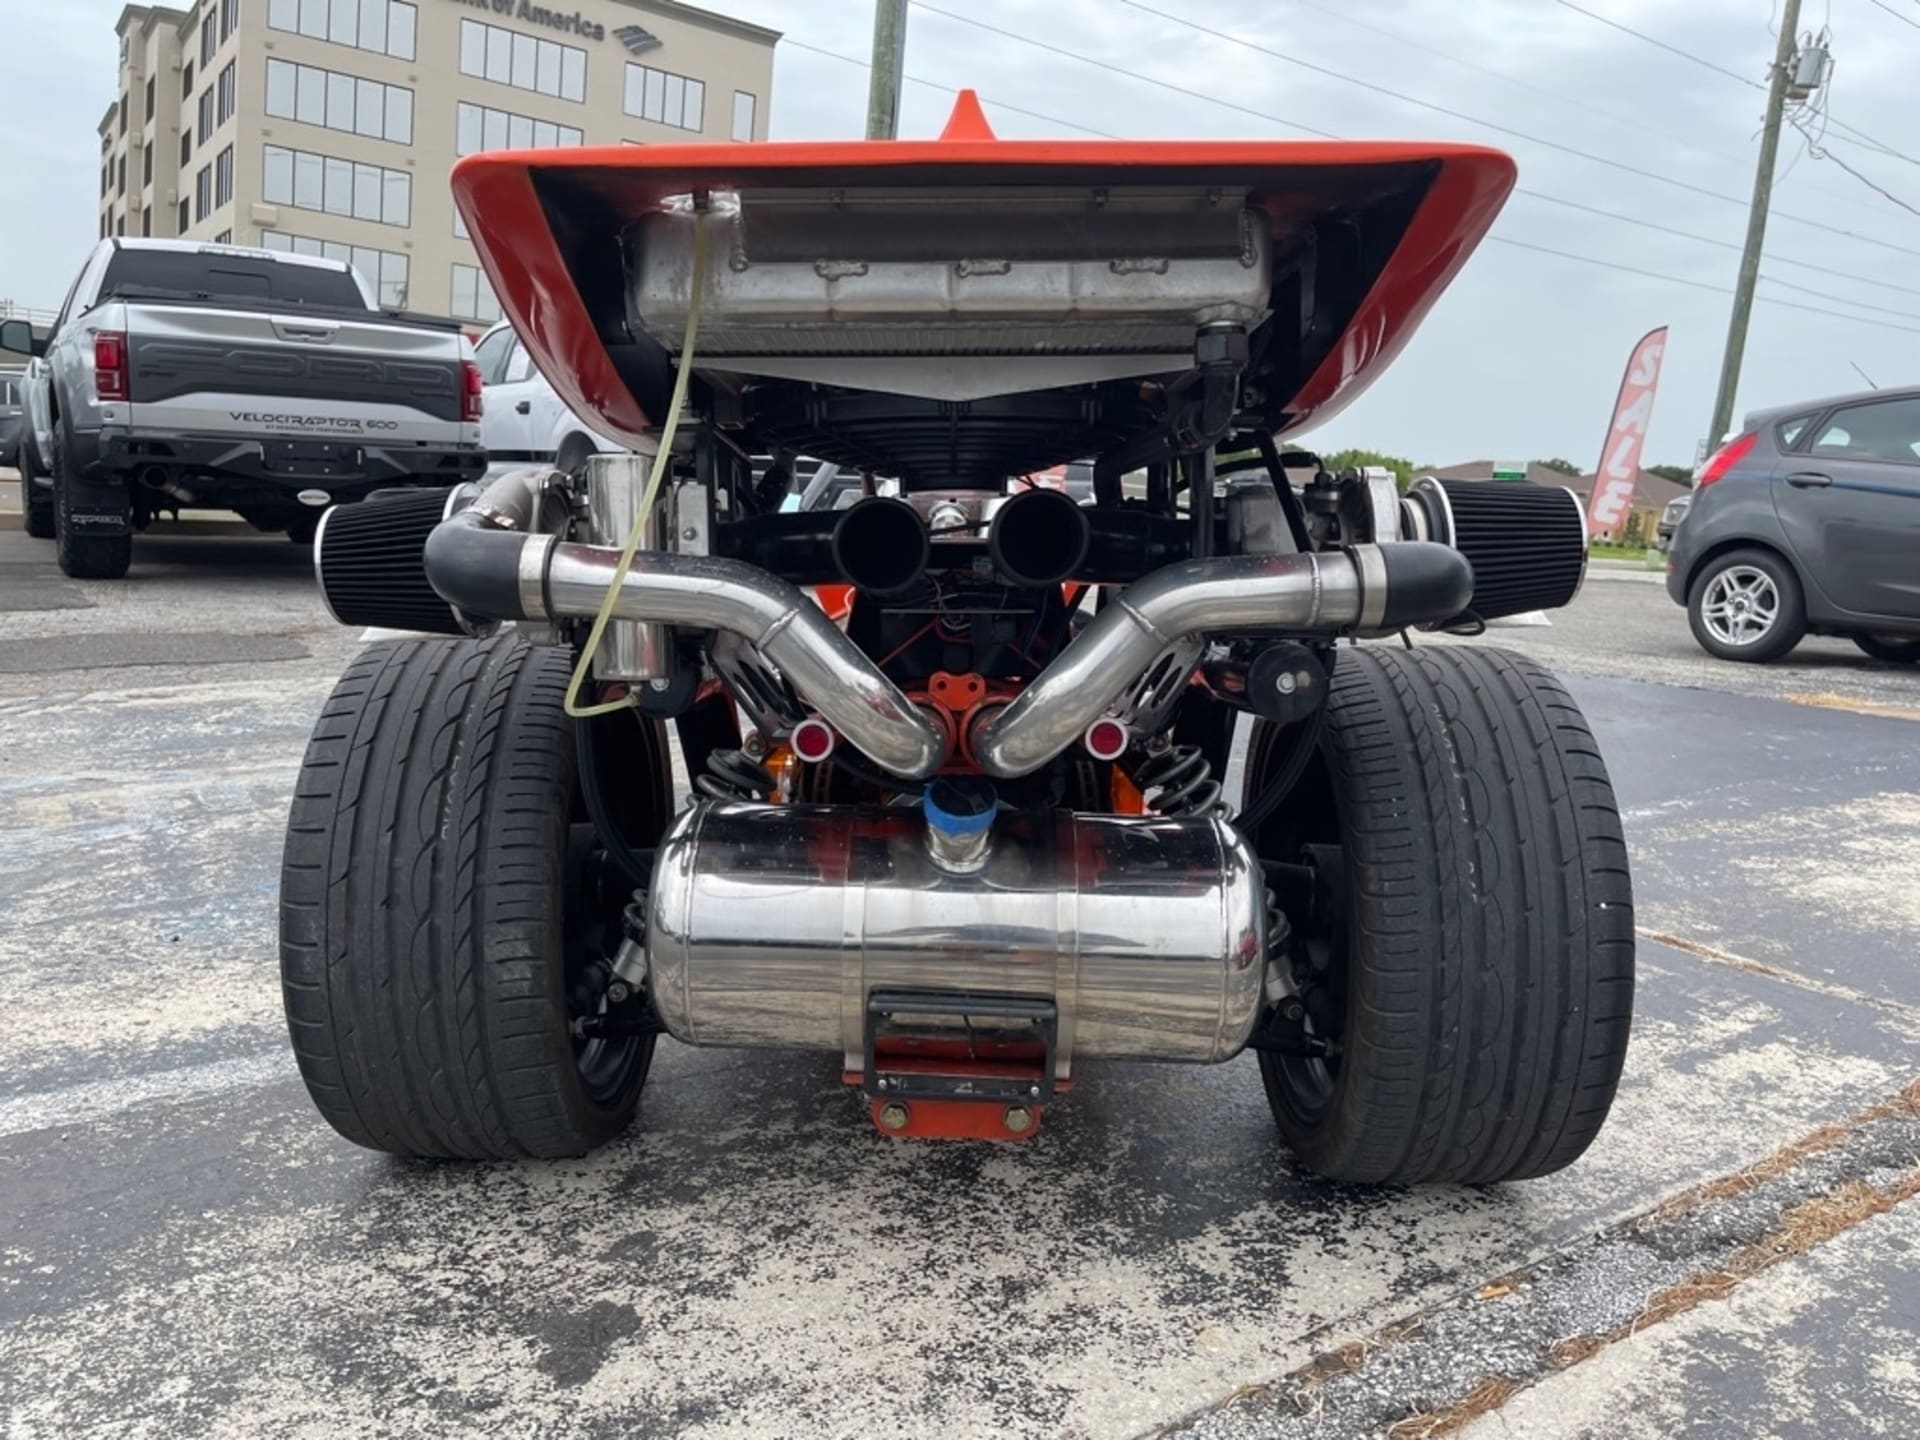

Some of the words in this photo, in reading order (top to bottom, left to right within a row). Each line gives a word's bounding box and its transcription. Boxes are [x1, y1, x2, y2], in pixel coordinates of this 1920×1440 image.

[492, 0, 514, 16] of
[517, 0, 604, 41] America
[230, 411, 361, 429] VELOCIRAPTOR
[366, 419, 399, 430] 600
[1594, 343, 1664, 525] SALE
